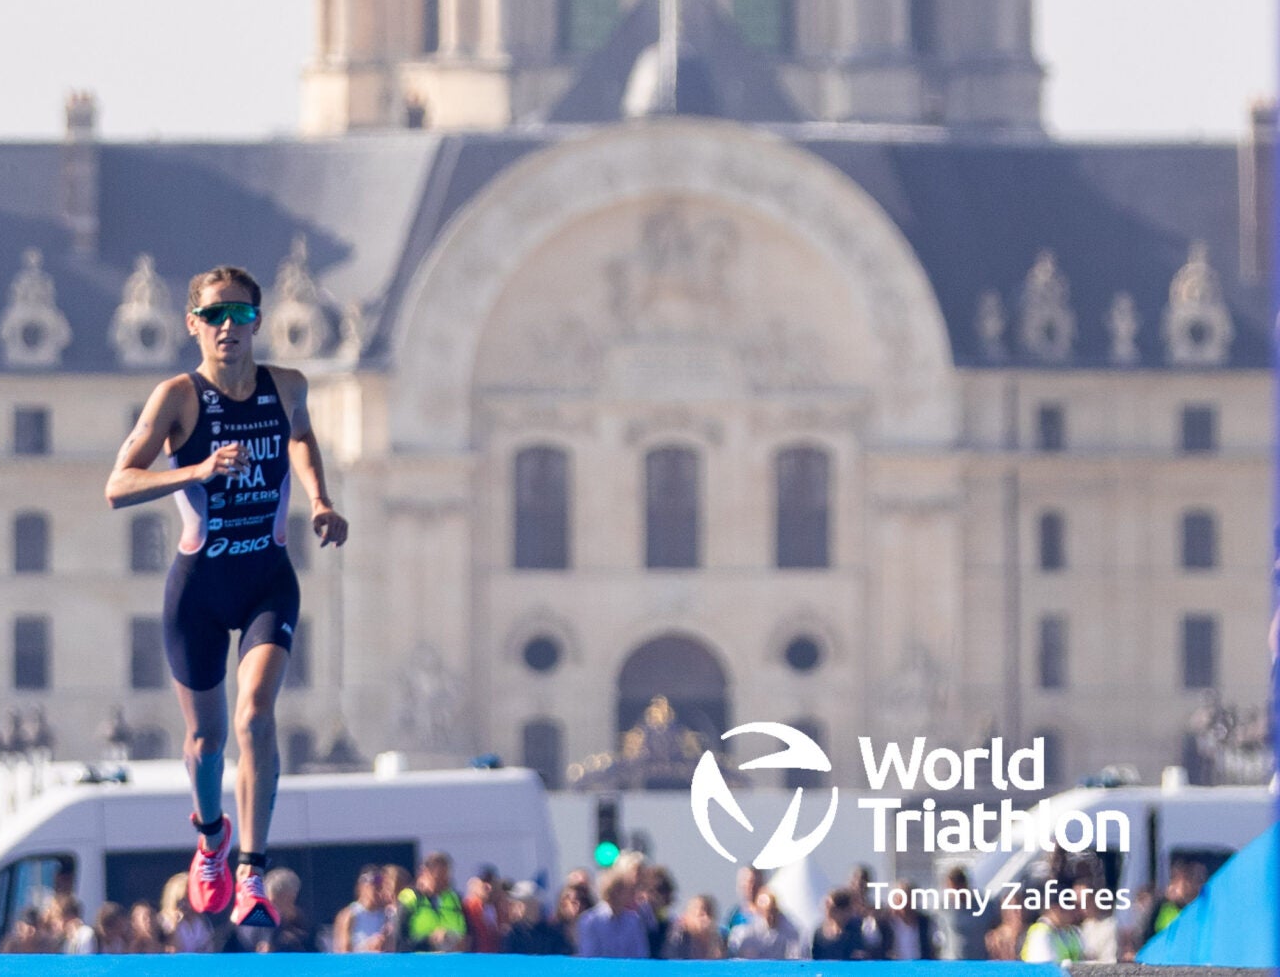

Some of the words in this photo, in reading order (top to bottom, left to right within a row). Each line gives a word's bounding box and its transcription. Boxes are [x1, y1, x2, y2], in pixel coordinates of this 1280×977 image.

[224, 419, 279, 431] VERSAILLES
[235, 489, 280, 503] SFERIS
[228, 534, 271, 555] asics
